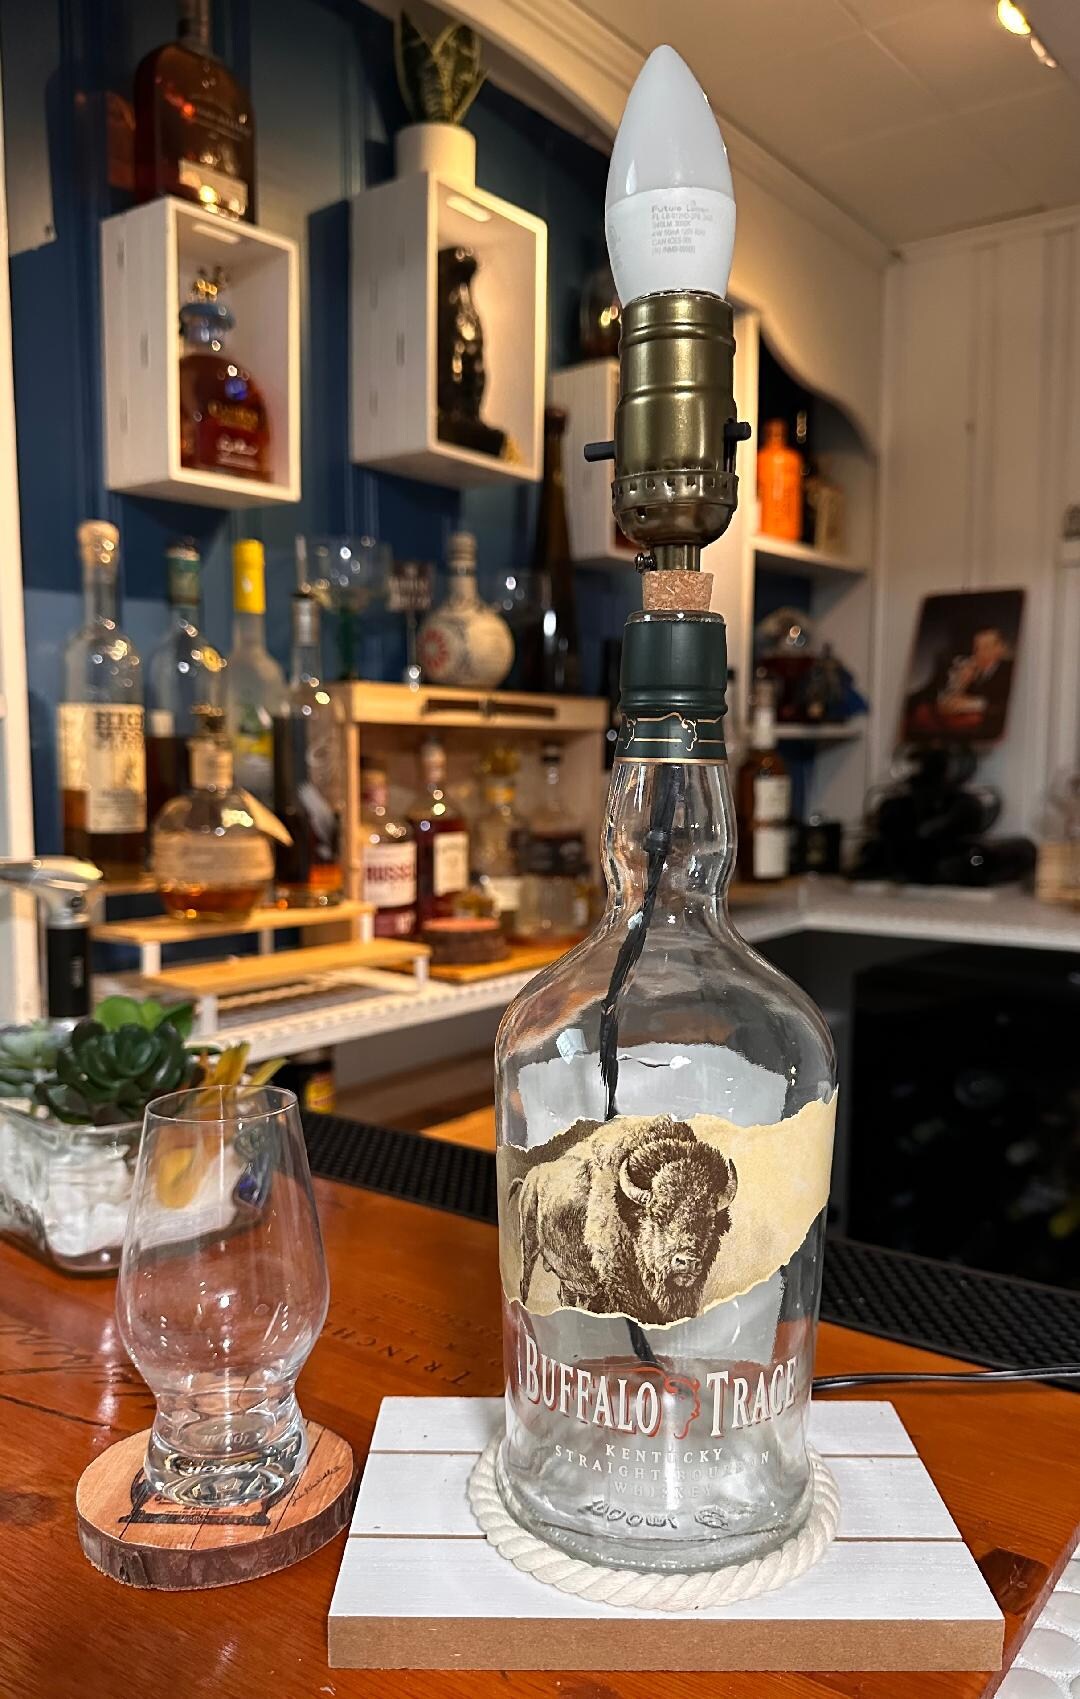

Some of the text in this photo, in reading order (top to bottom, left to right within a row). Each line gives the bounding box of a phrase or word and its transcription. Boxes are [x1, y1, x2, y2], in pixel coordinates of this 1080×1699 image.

[525, 1333, 800, 1439] BUFFALO TRACE
[555, 1444, 770, 1482] STRAIGHT BOUBN
[605, 1443, 723, 1465] KENTUCKY
